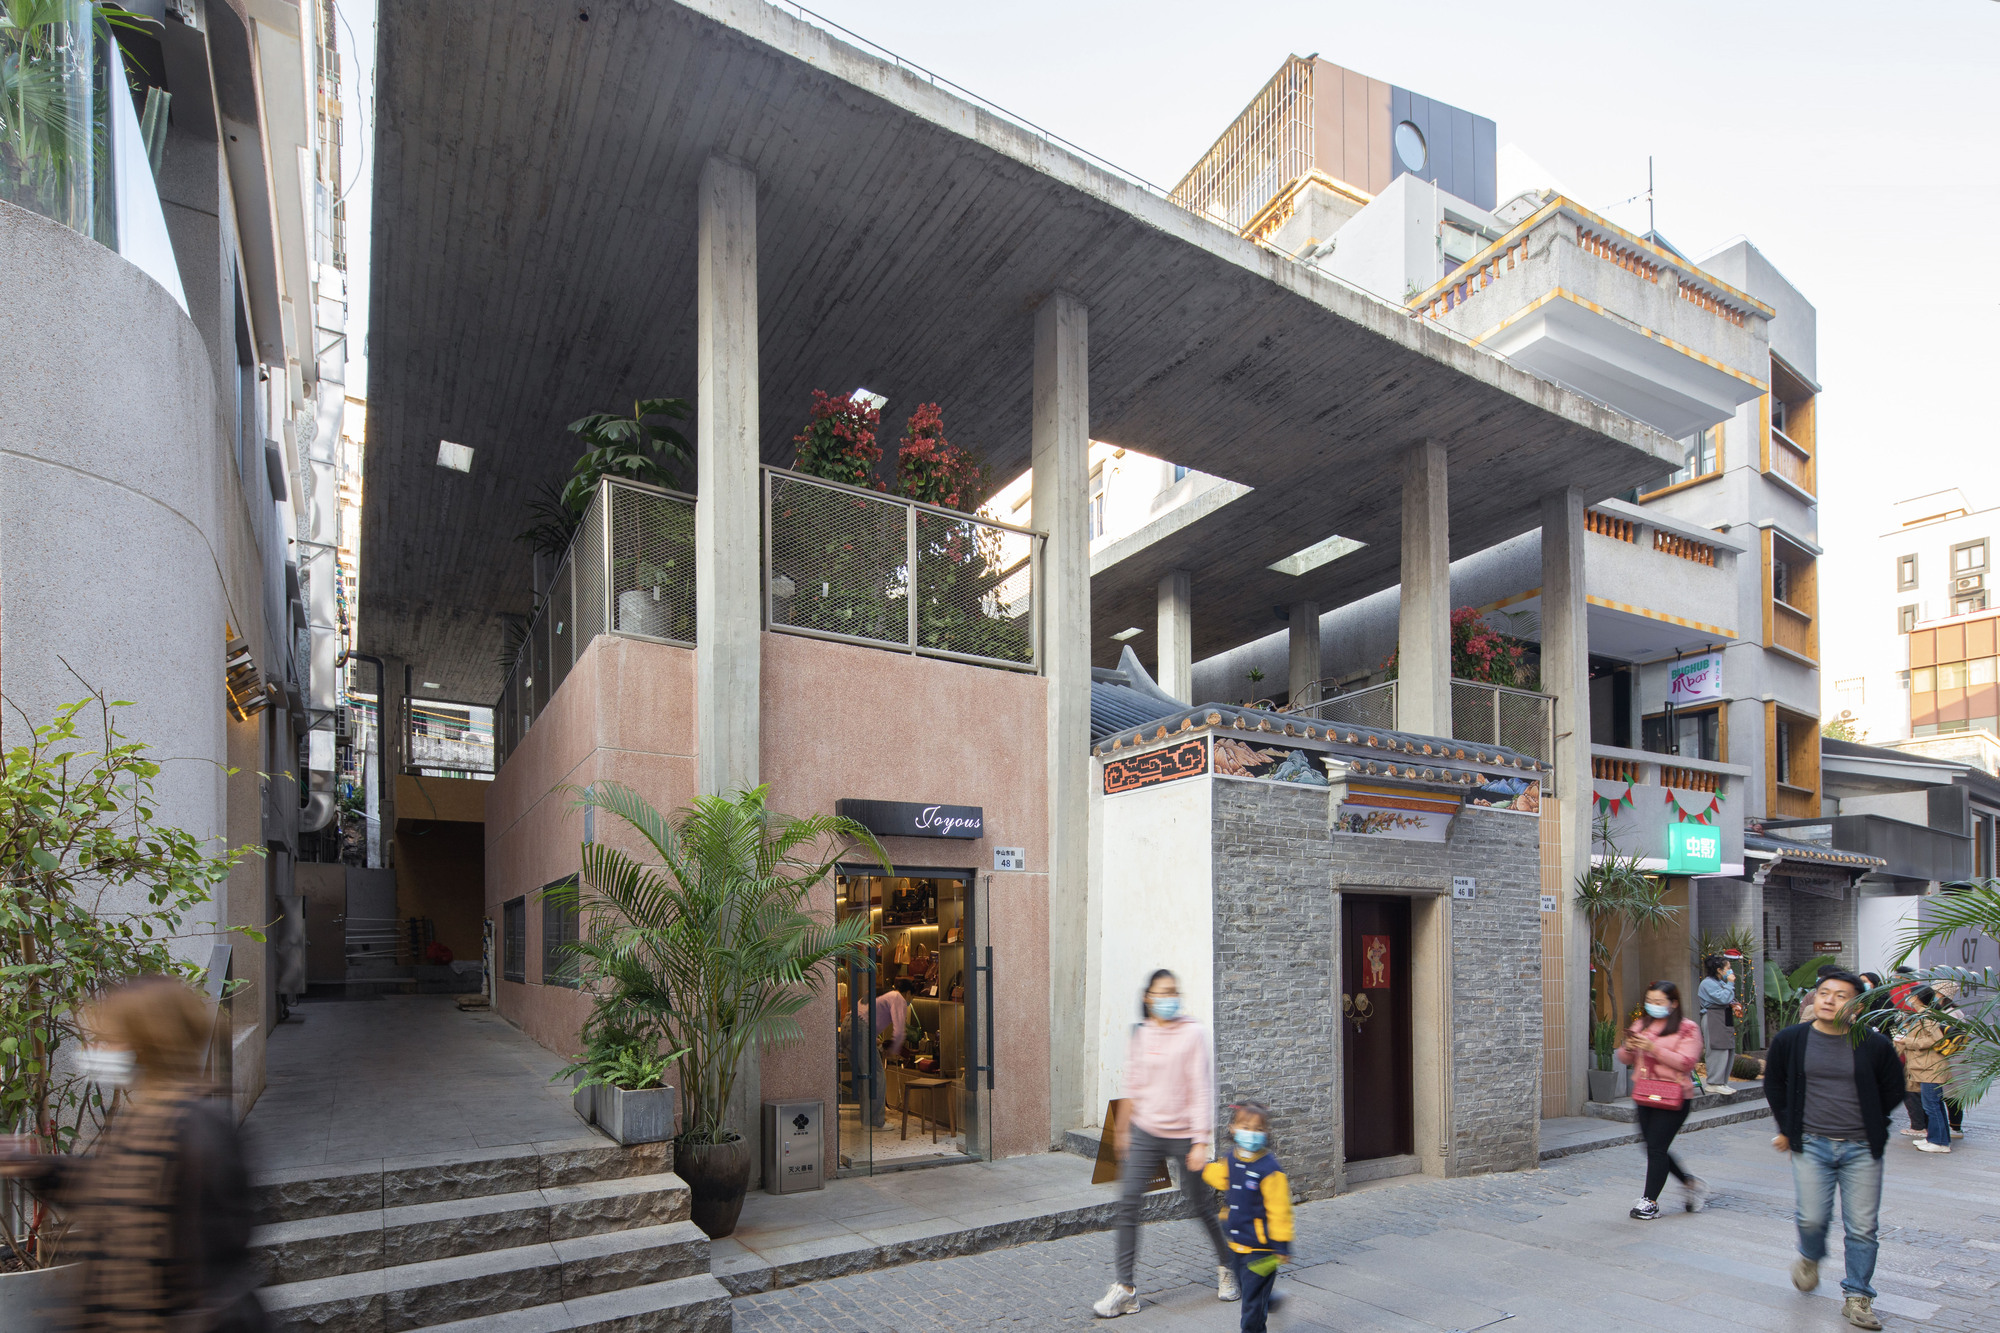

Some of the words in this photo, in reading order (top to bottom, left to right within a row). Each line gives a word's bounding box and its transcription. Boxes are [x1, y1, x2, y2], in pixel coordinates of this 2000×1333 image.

[914, 805, 981, 835] Joyous
[1001, 859, 1011, 868] 48
[1458, 888, 1466, 896] 46
[1962, 937, 1978, 965] 07
